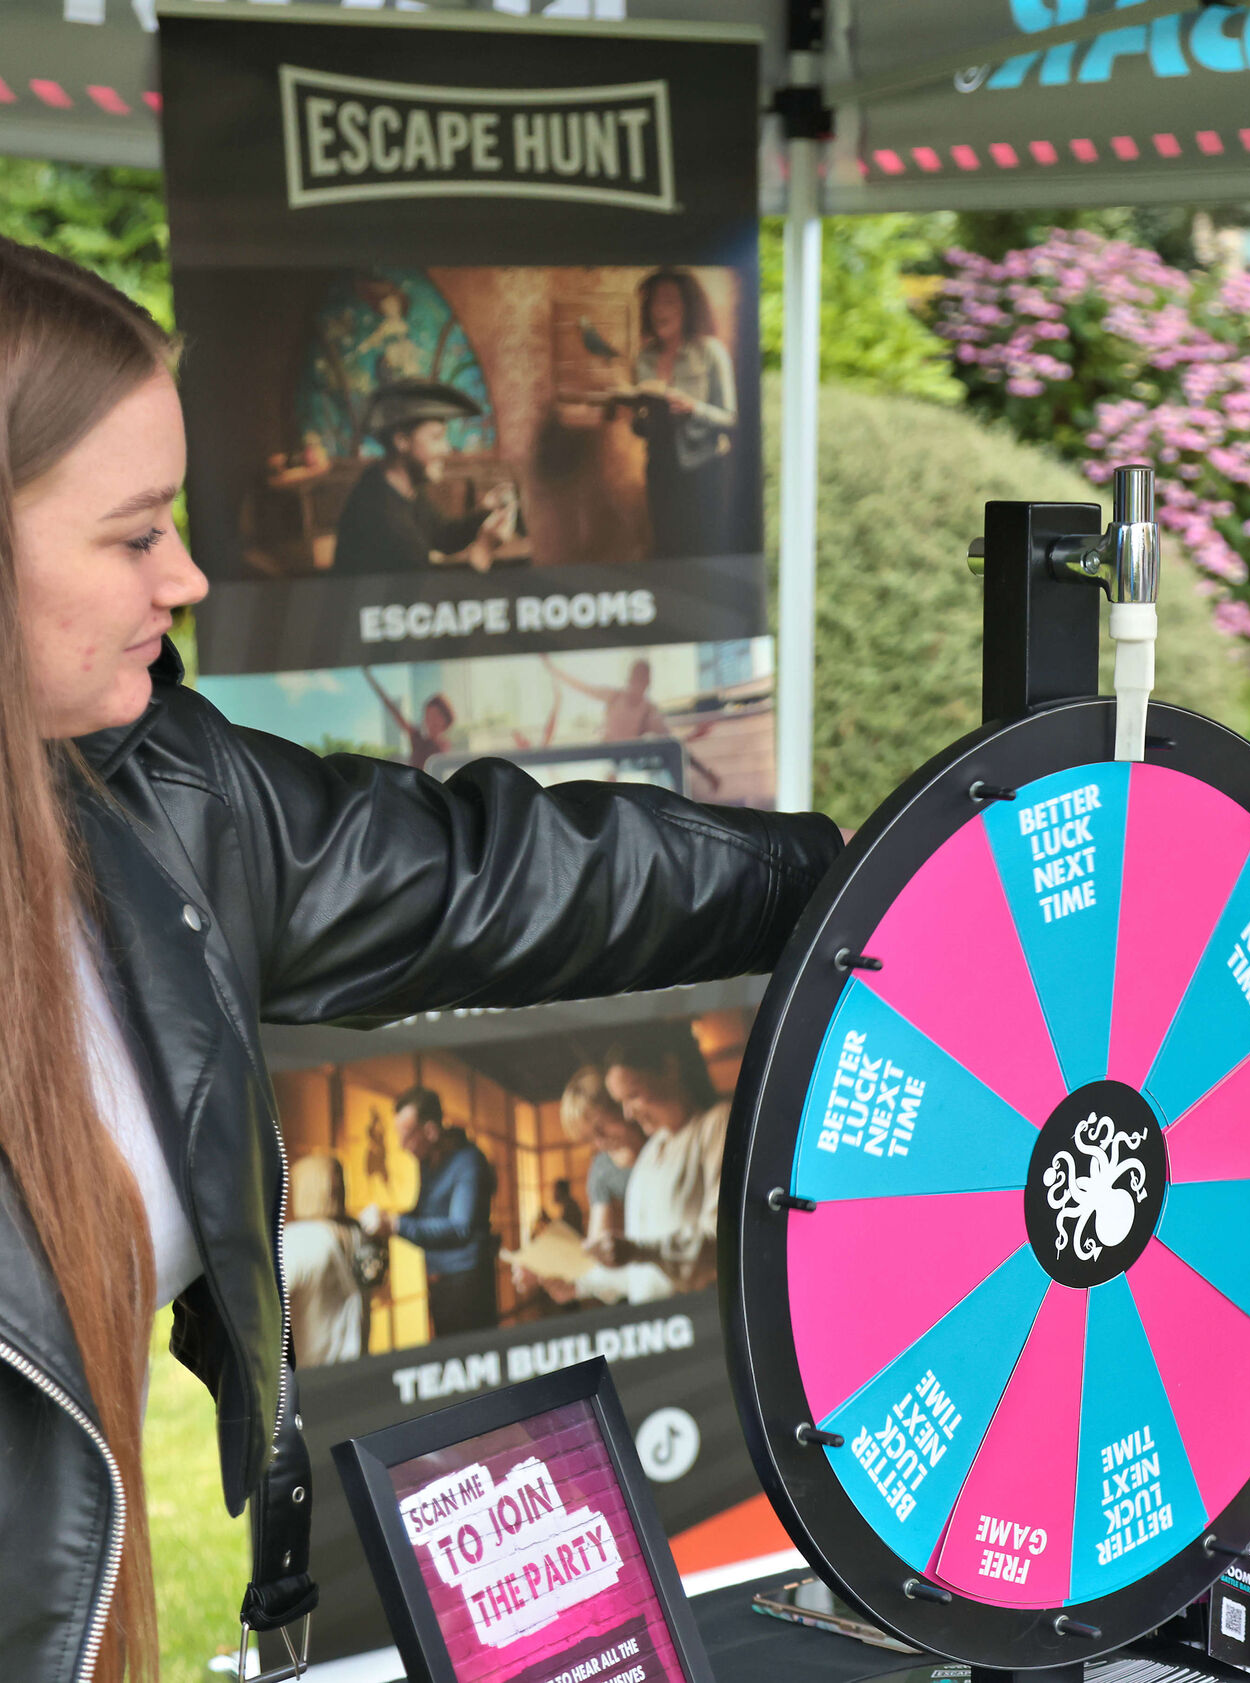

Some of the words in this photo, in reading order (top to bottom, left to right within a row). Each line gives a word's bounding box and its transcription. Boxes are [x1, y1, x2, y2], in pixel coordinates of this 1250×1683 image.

[306, 98, 500, 178] ESCAPE
[515, 109, 649, 181] HUNT
[359, 598, 510, 642] ESCAPE
[516, 589, 656, 632] ROOMS
[1018, 784, 1102, 836] BETTER
[1030, 815, 1094, 861] LUCK
[1033, 846, 1096, 893] NEXT
[1039, 880, 1096, 923] TIME
[817, 1029, 867, 1153] BETTER
[841, 1053, 883, 1147] LUCK
[863, 1060, 904, 1157] NEXT
[887, 1076, 926, 1156] TIME
[393, 1352, 499, 1403] TEAM
[507, 1314, 694, 1382] BUILDING
[892, 1392, 947, 1468] NEXT
[915, 1369, 962, 1440] TIME
[851, 1425, 917, 1523] BETTER
[874, 1414, 928, 1491] LUCK
[1101, 1425, 1155, 1473] TIME
[1101, 1451, 1161, 1506] NEXT
[410, 1489, 457, 1532] SCAN
[460, 1474, 485, 1507] ME
[439, 1524, 484, 1576] TO
[488, 1477, 554, 1546] JOIN
[1095, 1503, 1174, 1565] BETTER
[1103, 1481, 1163, 1535] LUCK
[975, 1515, 1047, 1555] GAME
[472, 1572, 525, 1628] THE
[529, 1525, 607, 1600] PARTY
[978, 1549, 1031, 1584] FREE
[571, 1658, 603, 1683] HEAR
[600, 1647, 622, 1670] ALL
[618, 1637, 640, 1660] THE
